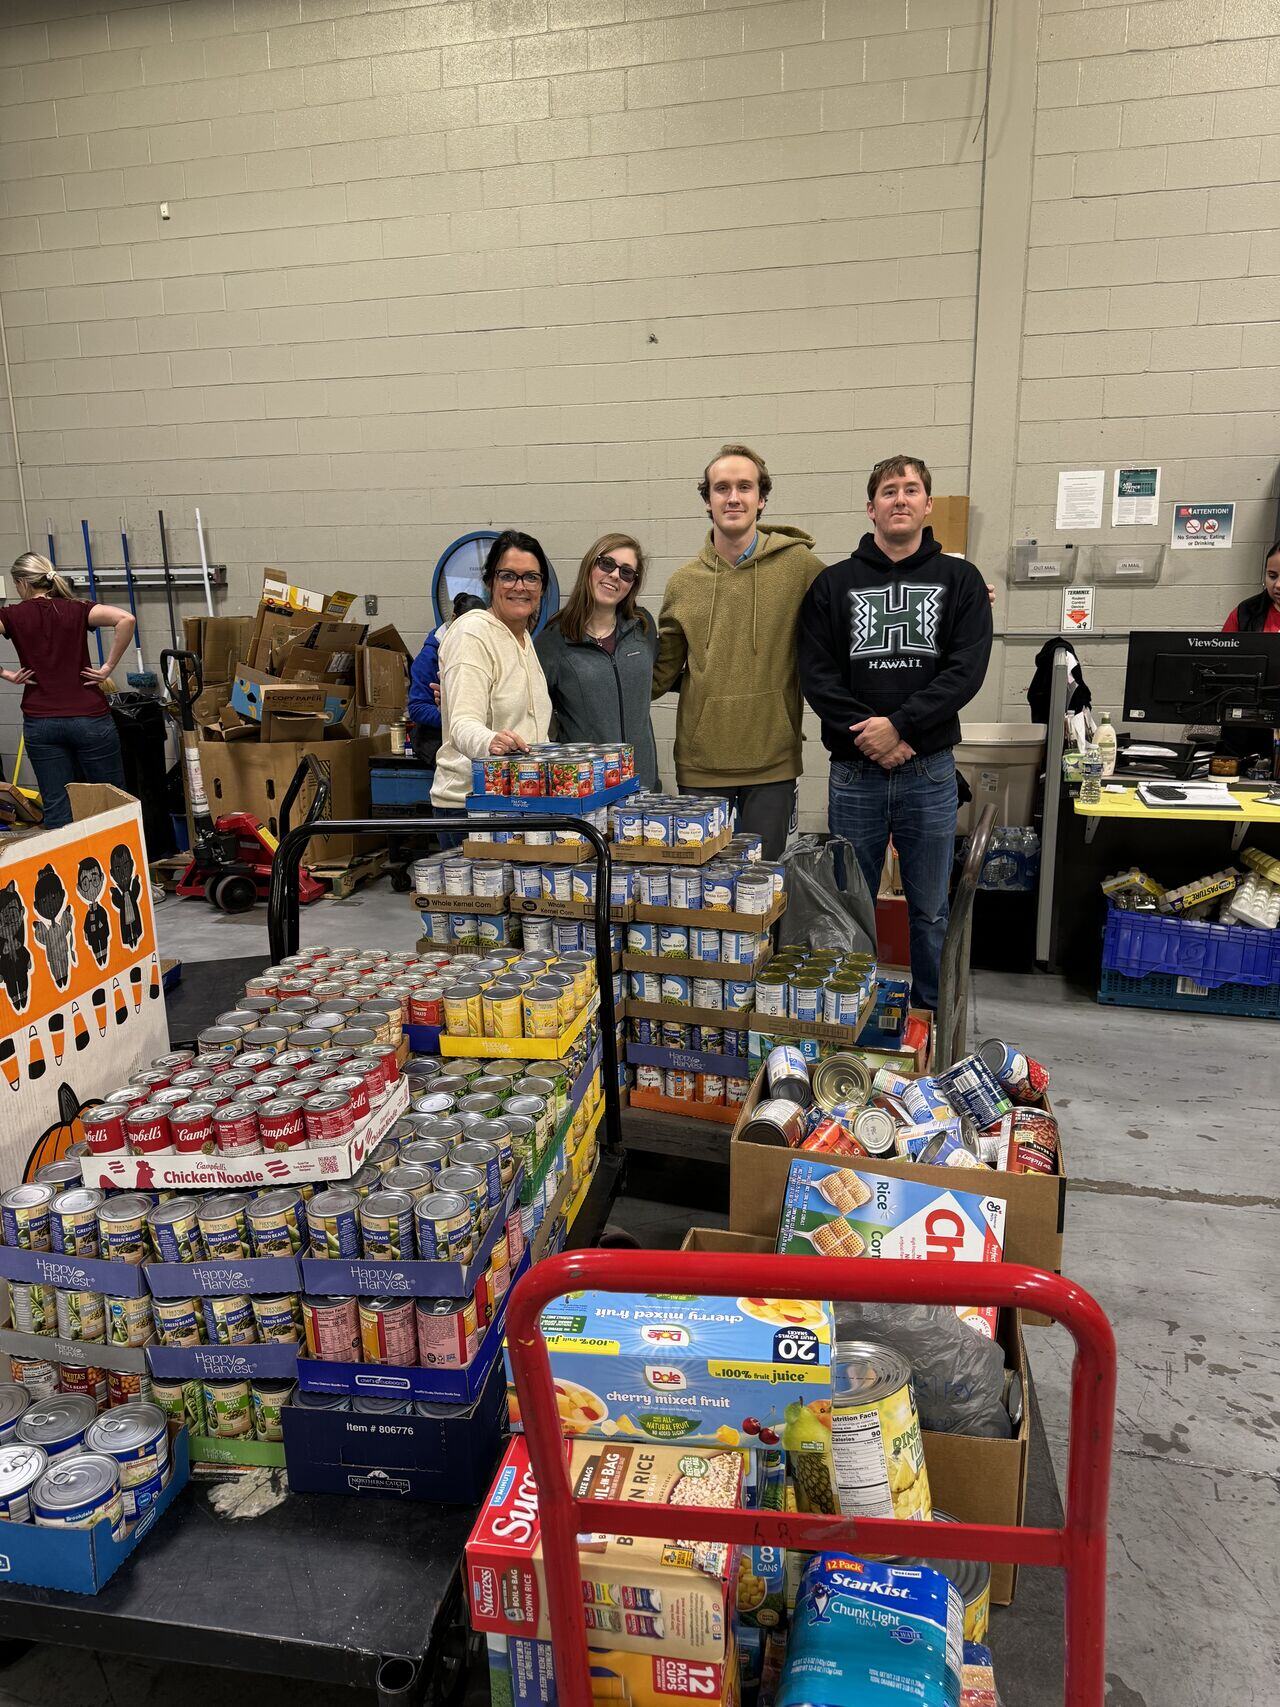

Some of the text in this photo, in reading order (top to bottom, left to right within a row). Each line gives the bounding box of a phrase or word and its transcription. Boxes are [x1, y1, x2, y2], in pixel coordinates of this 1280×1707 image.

[850, 584, 943, 656] H
[1188, 638, 1240, 648] ViewSonic
[1192, 885, 1219, 900] PASTURE
[804, 1043, 812, 1051] 8
[669, 1052, 694, 1062] Happy
[674, 1060, 704, 1070] Harvest
[86, 1129, 107, 1142] bell's
[129, 1126, 160, 1143] mpbell's
[195, 1160, 227, 1171] Campbell's
[1020, 1153, 1044, 1166] Hickory
[163, 1170, 263, 1184] Chicken Noodle
[877, 1182, 889, 1210] Rice
[925, 1208, 965, 1262] Ch
[36, 1258, 75, 1276] Happy
[350, 1266, 393, 1281] Happy
[43, 1270, 92, 1287] Harvest
[193, 1269, 232, 1280] Happy
[202, 1278, 251, 1290] Harvest
[358, 1277, 411, 1290] Harvest
[180, 1317, 194, 1325] BEANS
[228, 1313, 244, 1321] GREEN
[595, 1307, 630, 1319] fruit
[633, 1310, 684, 1321] mixed
[688, 1310, 744, 1324] cherry
[579, 1338, 608, 1346] 100%
[648, 1331, 681, 1341] Dole
[55, 1342, 76, 1352] Happy
[59, 1349, 86, 1358] Harvest
[778, 1340, 816, 1360] 20
[195, 1353, 235, 1365] Happy
[204, 1362, 254, 1374] Harvest
[722, 1369, 752, 1379] 100%
[652, 1371, 680, 1381] Dole
[607, 1391, 730, 1408] cherry mixed fruit
[346, 1422, 368, 1432] Item
[379, 1426, 414, 1435] 806776
[646, 1420, 689, 1430] NATURAL FRUIT
[632, 1454, 655, 1484] RICE
[352, 1478, 384, 1486] NORTHERN
[494, 1468, 512, 1504] 10 MINUTE
[578, 1466, 594, 1495] SIZE BAGS
[647, 1474, 657, 1496] GRAIN
[66, 1510, 94, 1522] Brookdale
[760, 1546, 774, 1563] 8
[757, 1564, 777, 1572] CANS
[826, 1560, 861, 1571] 12 Pack
[830, 1572, 910, 1598] StarKist
[480, 1569, 495, 1616] Success
[525, 1593, 534, 1622] BROWN
[831, 1602, 900, 1626] Chunk Light
[856, 1618, 876, 1627] TUNA
[666, 1661, 676, 1690] CUPS
[677, 1663, 688, 1692] PACK
[689, 1666, 714, 1694] 12
